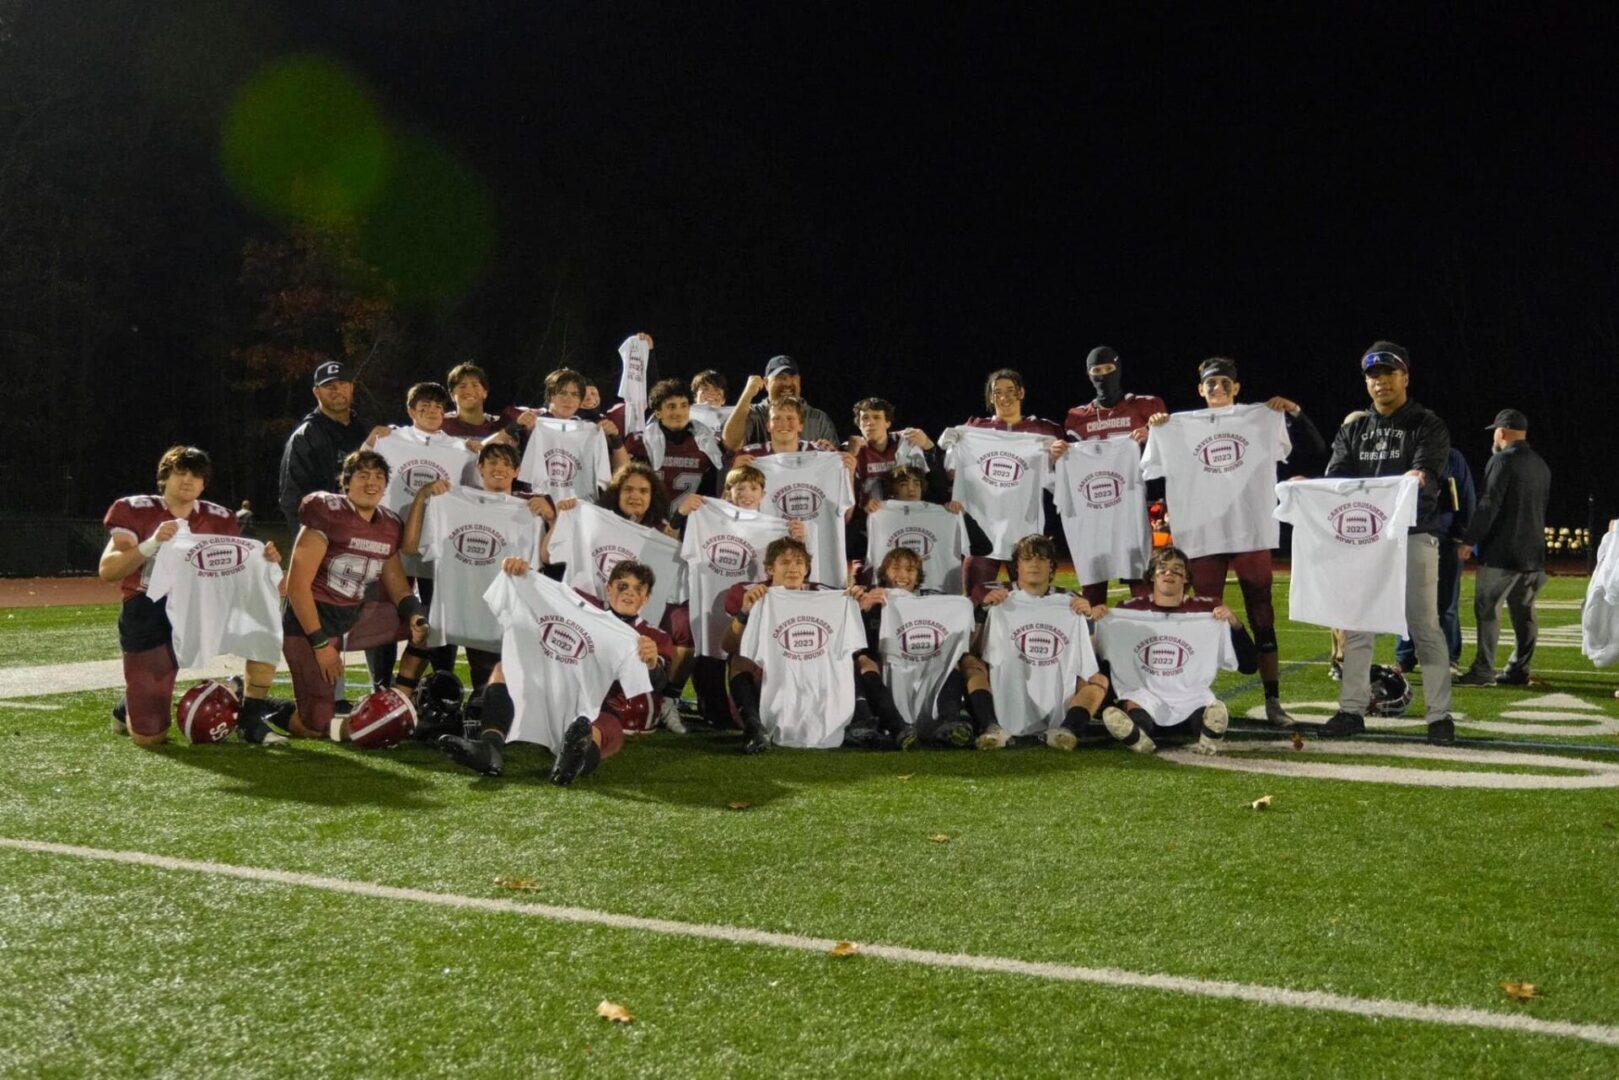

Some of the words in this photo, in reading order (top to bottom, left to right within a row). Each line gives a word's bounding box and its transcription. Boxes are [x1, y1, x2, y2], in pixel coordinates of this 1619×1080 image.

[327, 364, 340, 375] C
[1212, 454, 1232, 463] 2023
[992, 470, 1010, 478] 2023
[1094, 490, 1112, 498] 2023
[791, 503, 809, 511] 2023
[466, 545, 486, 554] 2023
[209, 557, 232, 567] 2023
[718, 556, 738, 566] 2023
[552, 637, 572, 651] 2023
[793, 639, 814, 648] 2023
[911, 642, 931, 650] 2023
[1028, 646, 1049, 654] 2023
[1152, 657, 1173, 665] 2023
